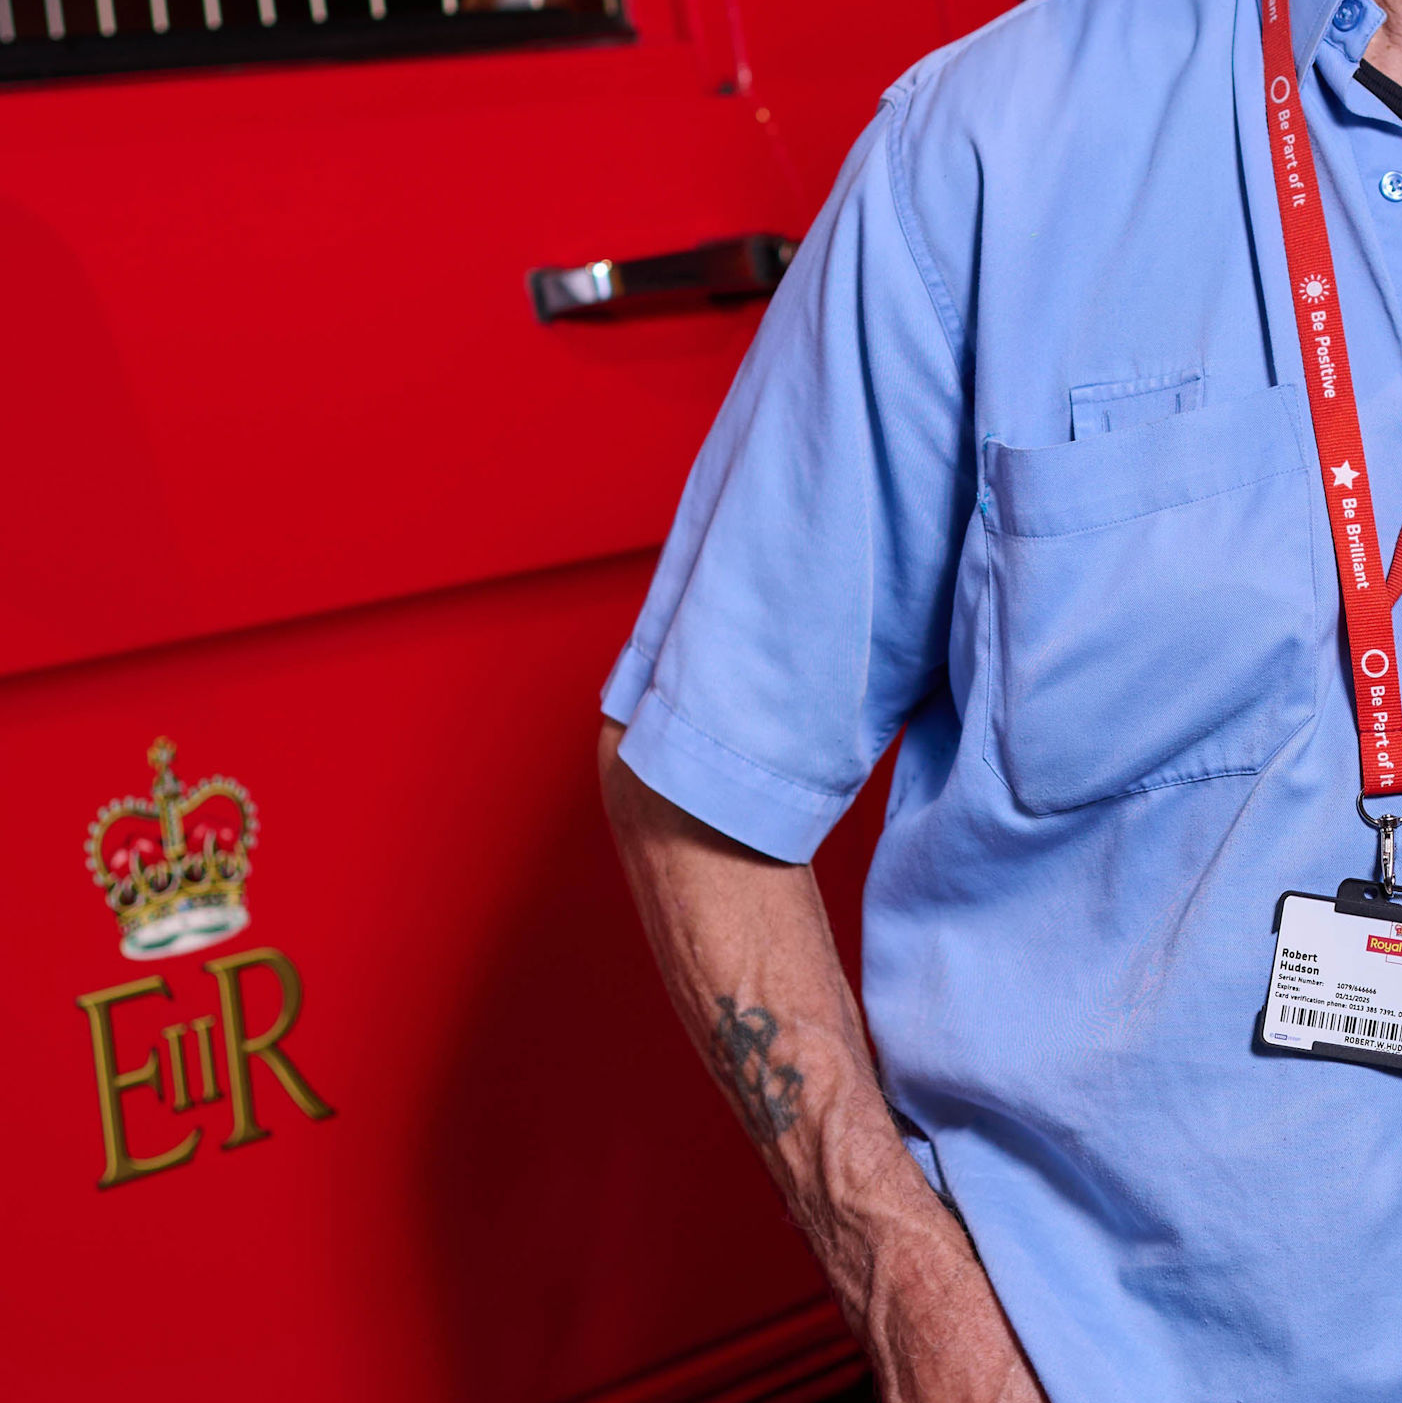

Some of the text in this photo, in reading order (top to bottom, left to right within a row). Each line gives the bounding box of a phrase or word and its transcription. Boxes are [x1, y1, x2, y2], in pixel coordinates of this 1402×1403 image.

[1278, 109, 1306, 208] Be Part of It
[1311, 310, 1337, 398] Be Positive
[1342, 498, 1370, 590] Be Brilliant
[1370, 685, 1395, 788] Be Part of It
[1370, 938, 1402, 953] Royal
[1282, 948, 1318, 962] Robert
[1280, 960, 1320, 975] Hudson
[1277, 983, 1300, 992] Expires:
[1278, 973, 1296, 982] Serial
[1298, 977, 1325, 986] Number:
[1275, 991, 1289, 999] Card
[1291, 995, 1325, 1004] verification
[1326, 1001, 1347, 1009] phone:
